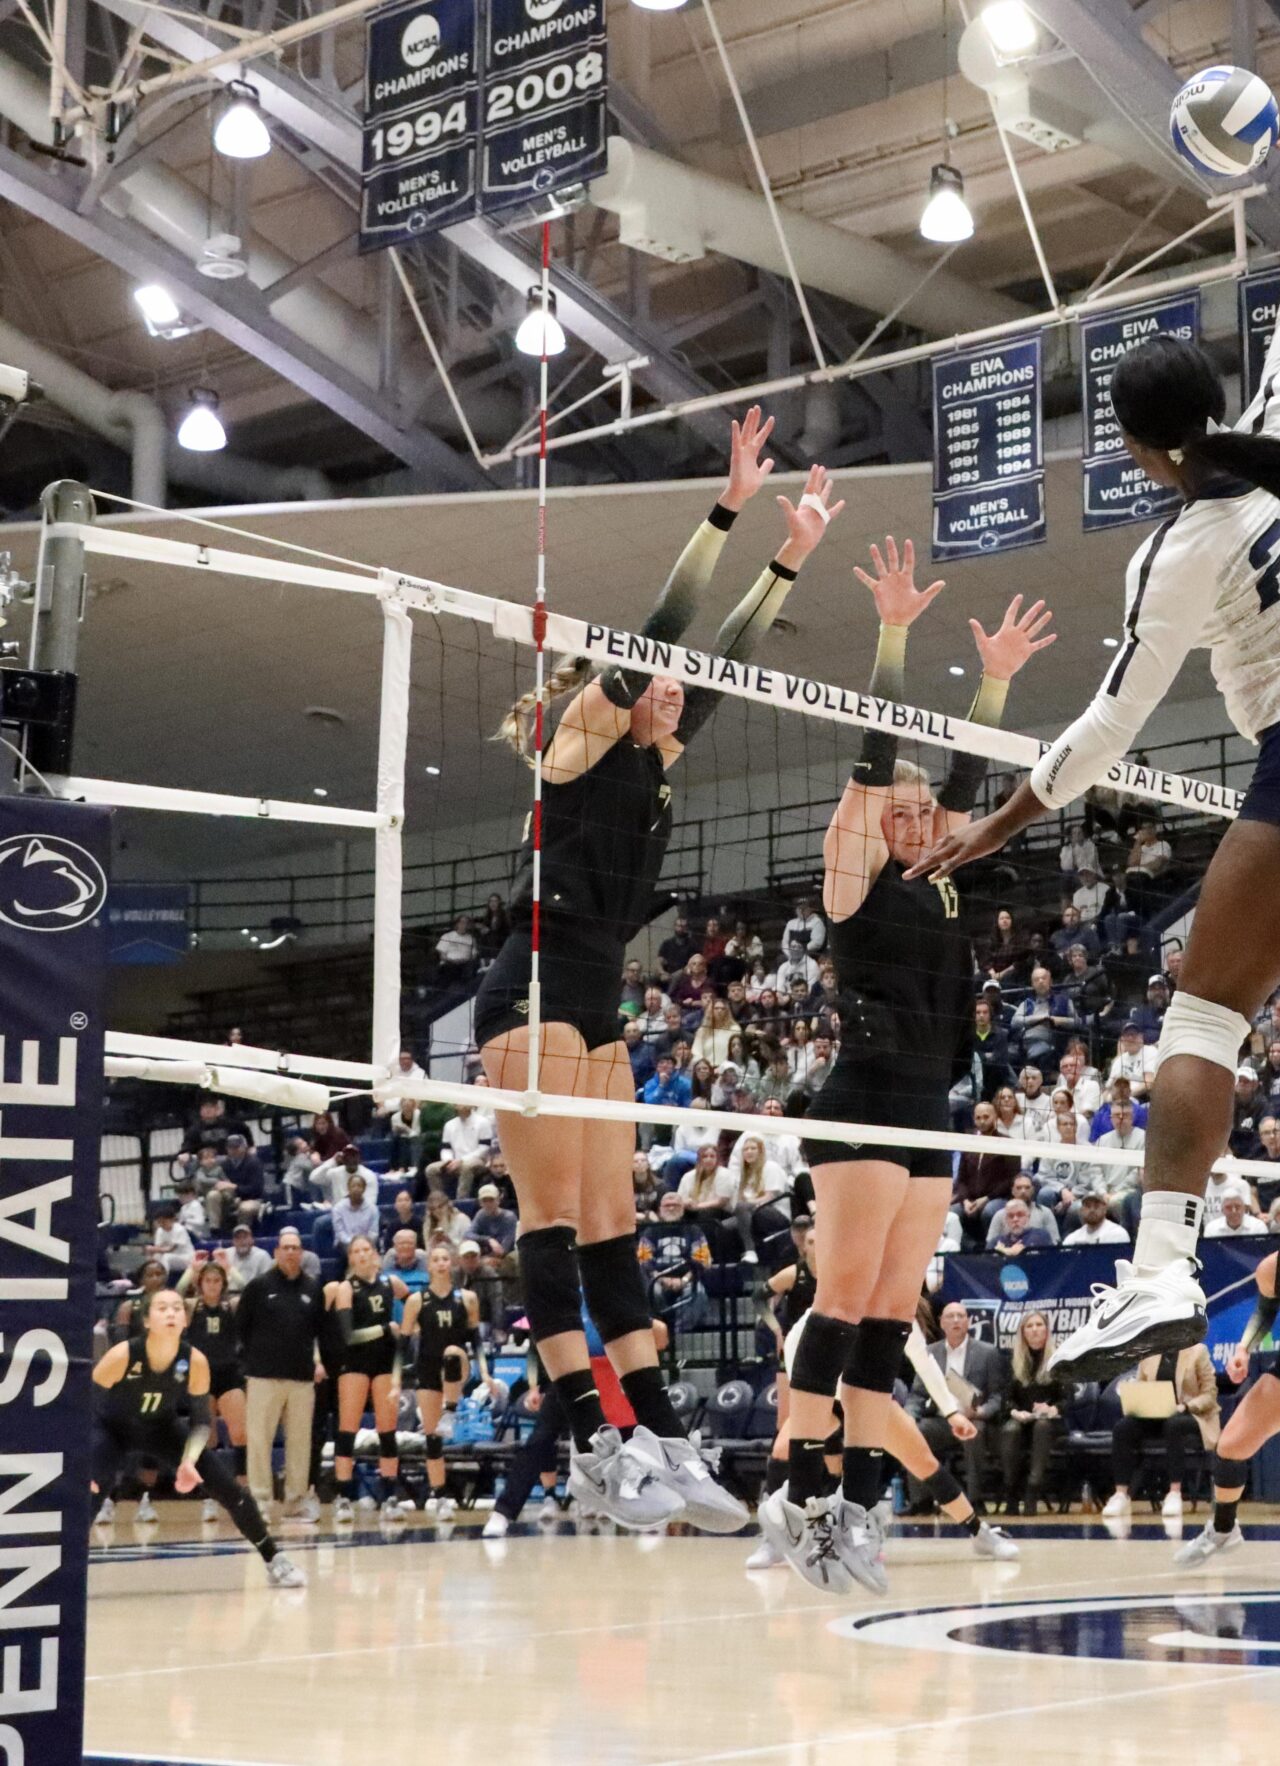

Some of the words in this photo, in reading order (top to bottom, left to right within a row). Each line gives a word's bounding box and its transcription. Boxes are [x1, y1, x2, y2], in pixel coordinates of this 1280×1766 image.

[494, 4, 597, 56] CHAMPIONS
[406, 35, 440, 57] NCAA
[374, 52, 469, 100] CHAMPIONS
[486, 52, 603, 122] 2008
[371, 100, 467, 161] 1994
[522, 126, 567, 152] MEN'S
[501, 136, 587, 176] VOLLEYBALL
[398, 170, 441, 195] MEN'S
[377, 180, 459, 216] VOLLEYBALL
[1122, 317, 1159, 339] EIVA
[970, 356, 1005, 377] EIVA
[1095, 373, 1112, 387] 19
[942, 365, 1034, 399] CHAMPIONS
[947, 406, 978, 423] 1981
[995, 394, 1030, 412] 1984
[1095, 390, 1112, 403] 19
[946, 422, 979, 439] 1985
[947, 438, 980, 454] 1987
[996, 426, 1031, 443] 1989
[949, 454, 978, 470] 1991
[996, 442, 1032, 460] 1992
[1094, 437, 1125, 453] 200
[947, 470, 980, 486] 1993
[996, 458, 1032, 476] 1994
[950, 508, 1029, 533] VOLLEYBALL
[969, 498, 1009, 516] MEN'S
[585, 624, 672, 669] PENN
[684, 650, 772, 693] STATE
[785, 674, 955, 741] VOLLEYBALL
[1107, 762, 1172, 795] STATE
[1181, 776, 1246, 811] VOLLE
[368, 1295, 384, 1313] 12
[436, 1309, 452, 1328] 14
